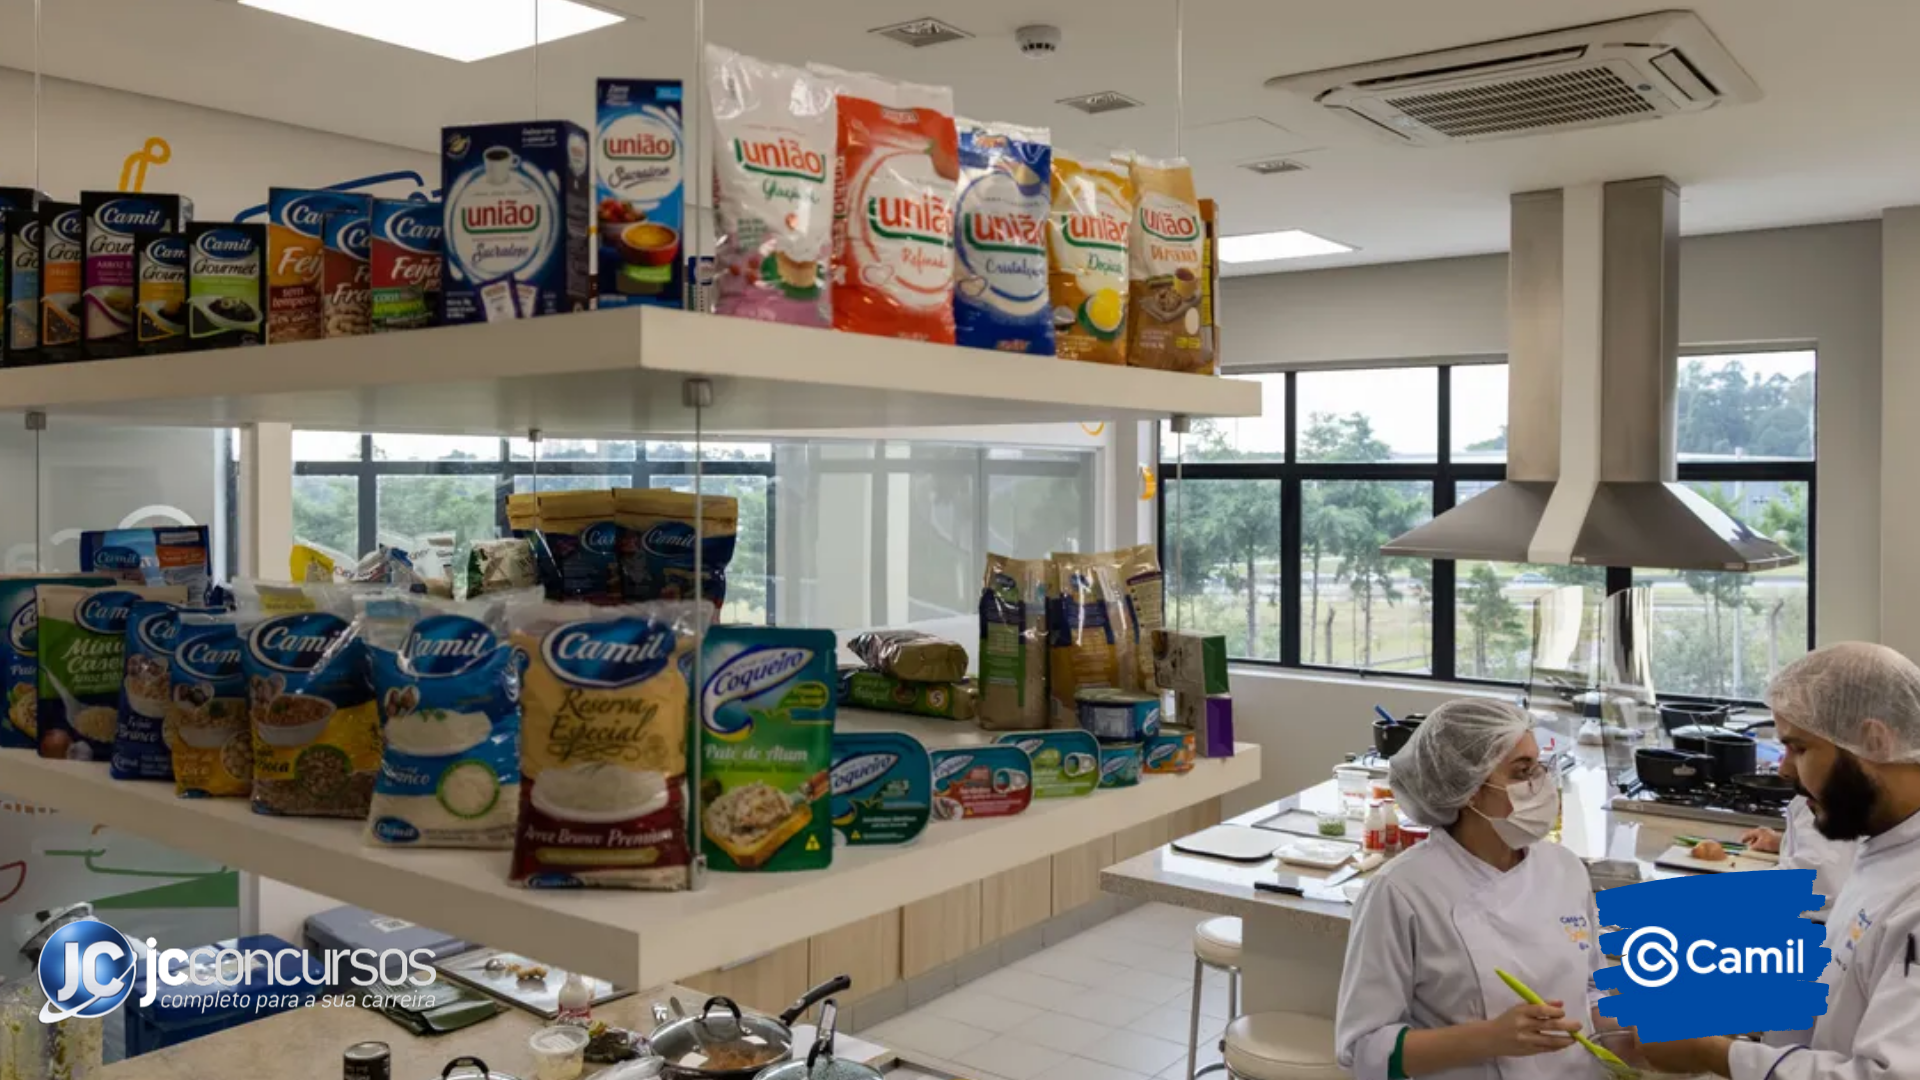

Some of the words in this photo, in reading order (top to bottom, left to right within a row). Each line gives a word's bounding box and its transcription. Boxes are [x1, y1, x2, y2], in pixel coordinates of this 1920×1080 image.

[608, 134, 672, 155] união
[742, 138, 823, 174] união
[103, 207, 161, 226] Camil
[467, 201, 535, 228] união
[396, 217, 442, 239] Cam
[90, 235, 133, 254] Gour
[153, 244, 186, 259] Cam
[203, 231, 251, 251] Camil
[193, 259, 259, 275] Gourmet
[277, 246, 323, 282] Feij
[391, 256, 442, 285] Feijã
[649, 530, 695, 548] Camil
[84, 601, 129, 619] Cam
[188, 644, 242, 664] Cam
[557, 630, 663, 664] Camil
[713, 651, 804, 696] Coqueiro
[557, 689, 648, 721] Reserva
[550, 704, 659, 758] Especial
[606, 827, 673, 847] Premium
